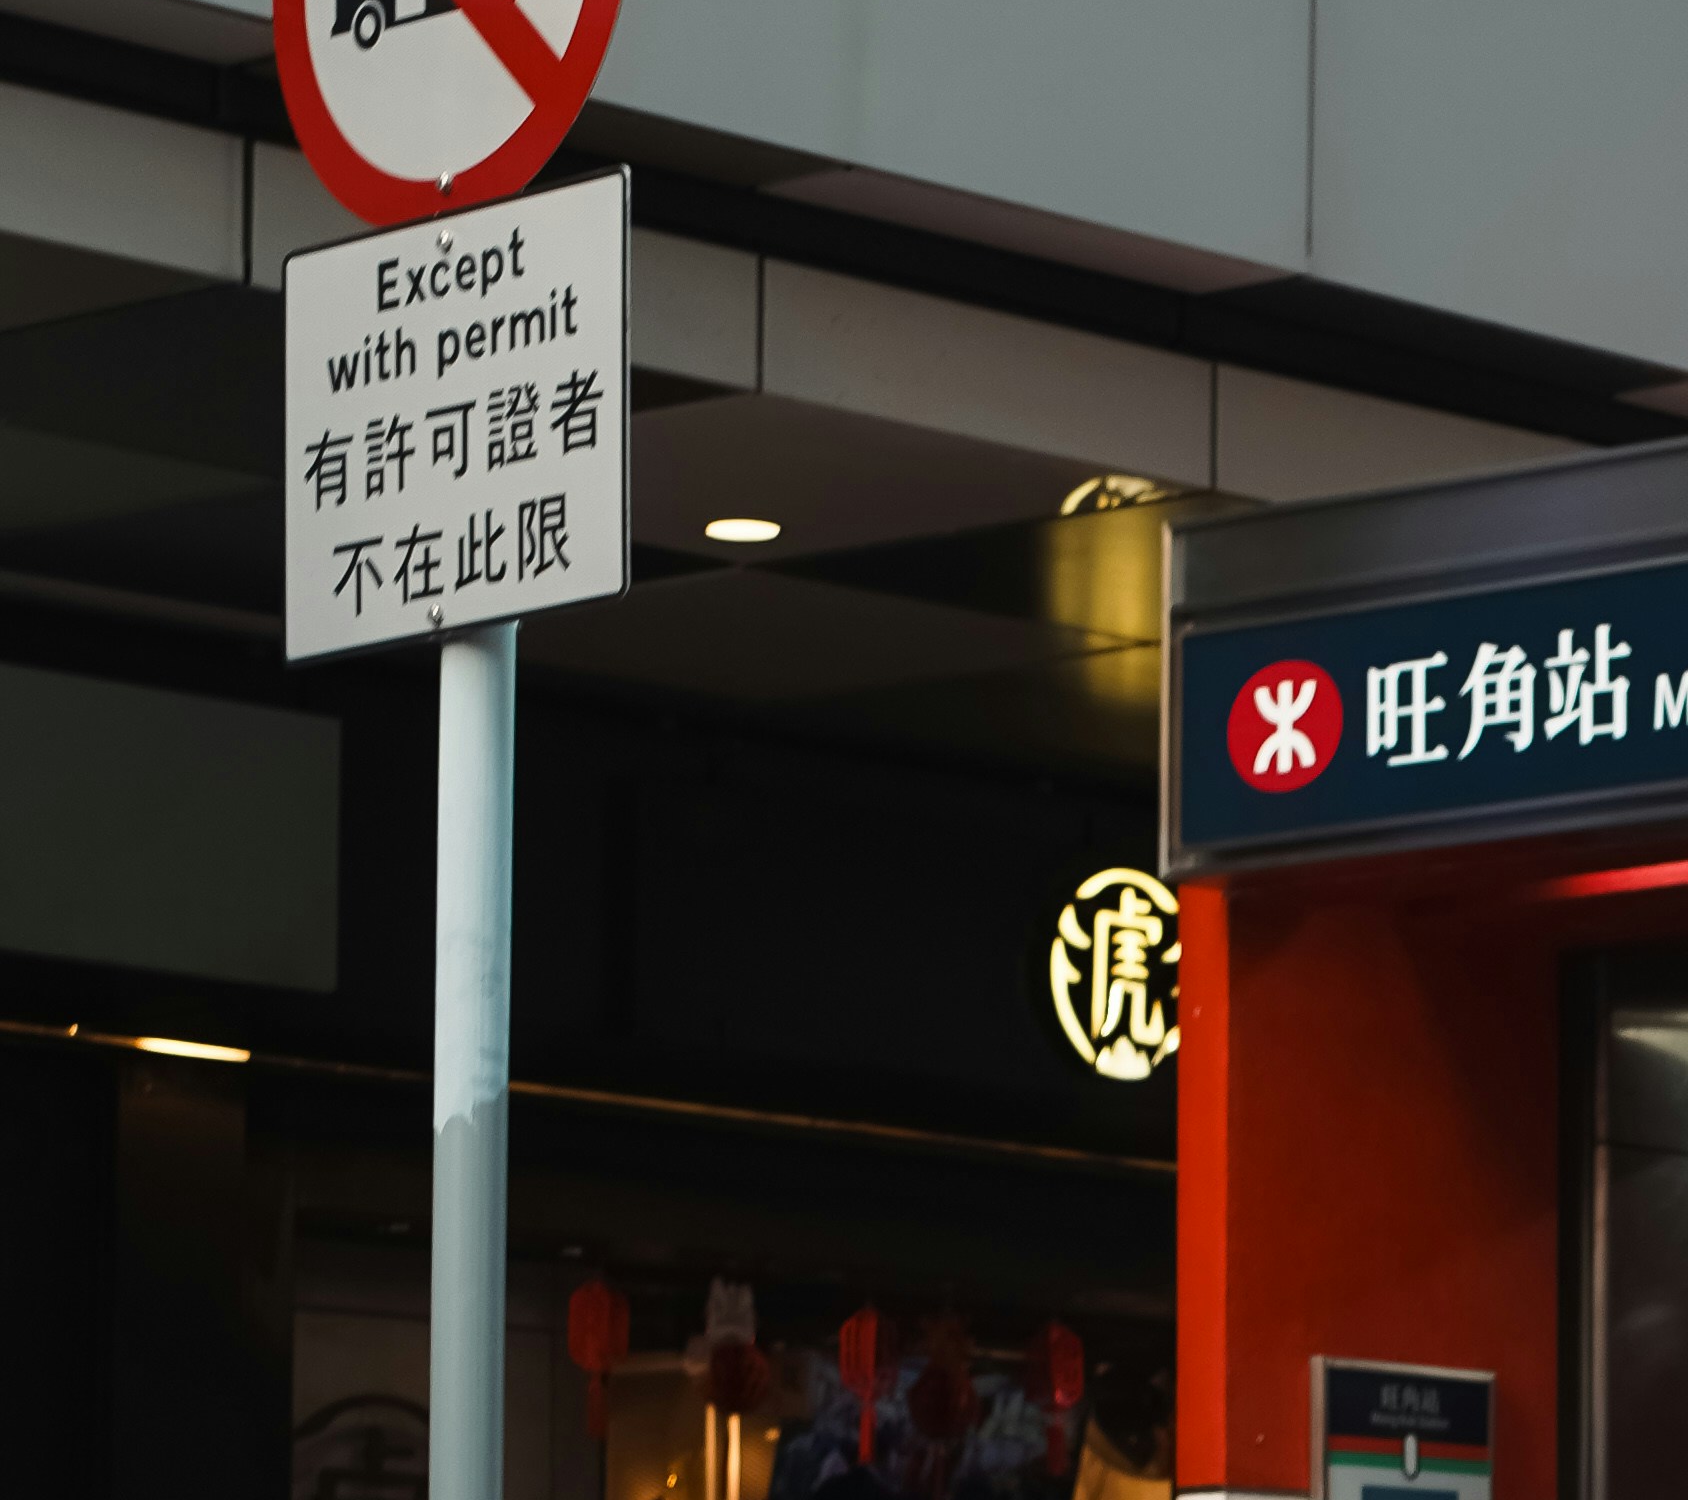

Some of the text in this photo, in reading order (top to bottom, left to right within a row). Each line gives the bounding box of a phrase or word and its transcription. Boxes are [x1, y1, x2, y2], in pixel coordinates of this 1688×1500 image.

[376, 225, 526, 314] Except
[327, 283, 579, 395] with permit
[303, 368, 605, 513] 有許可證者
[331, 491, 572, 618] 不在此限
[1365, 622, 1632, 767] 旺角站
